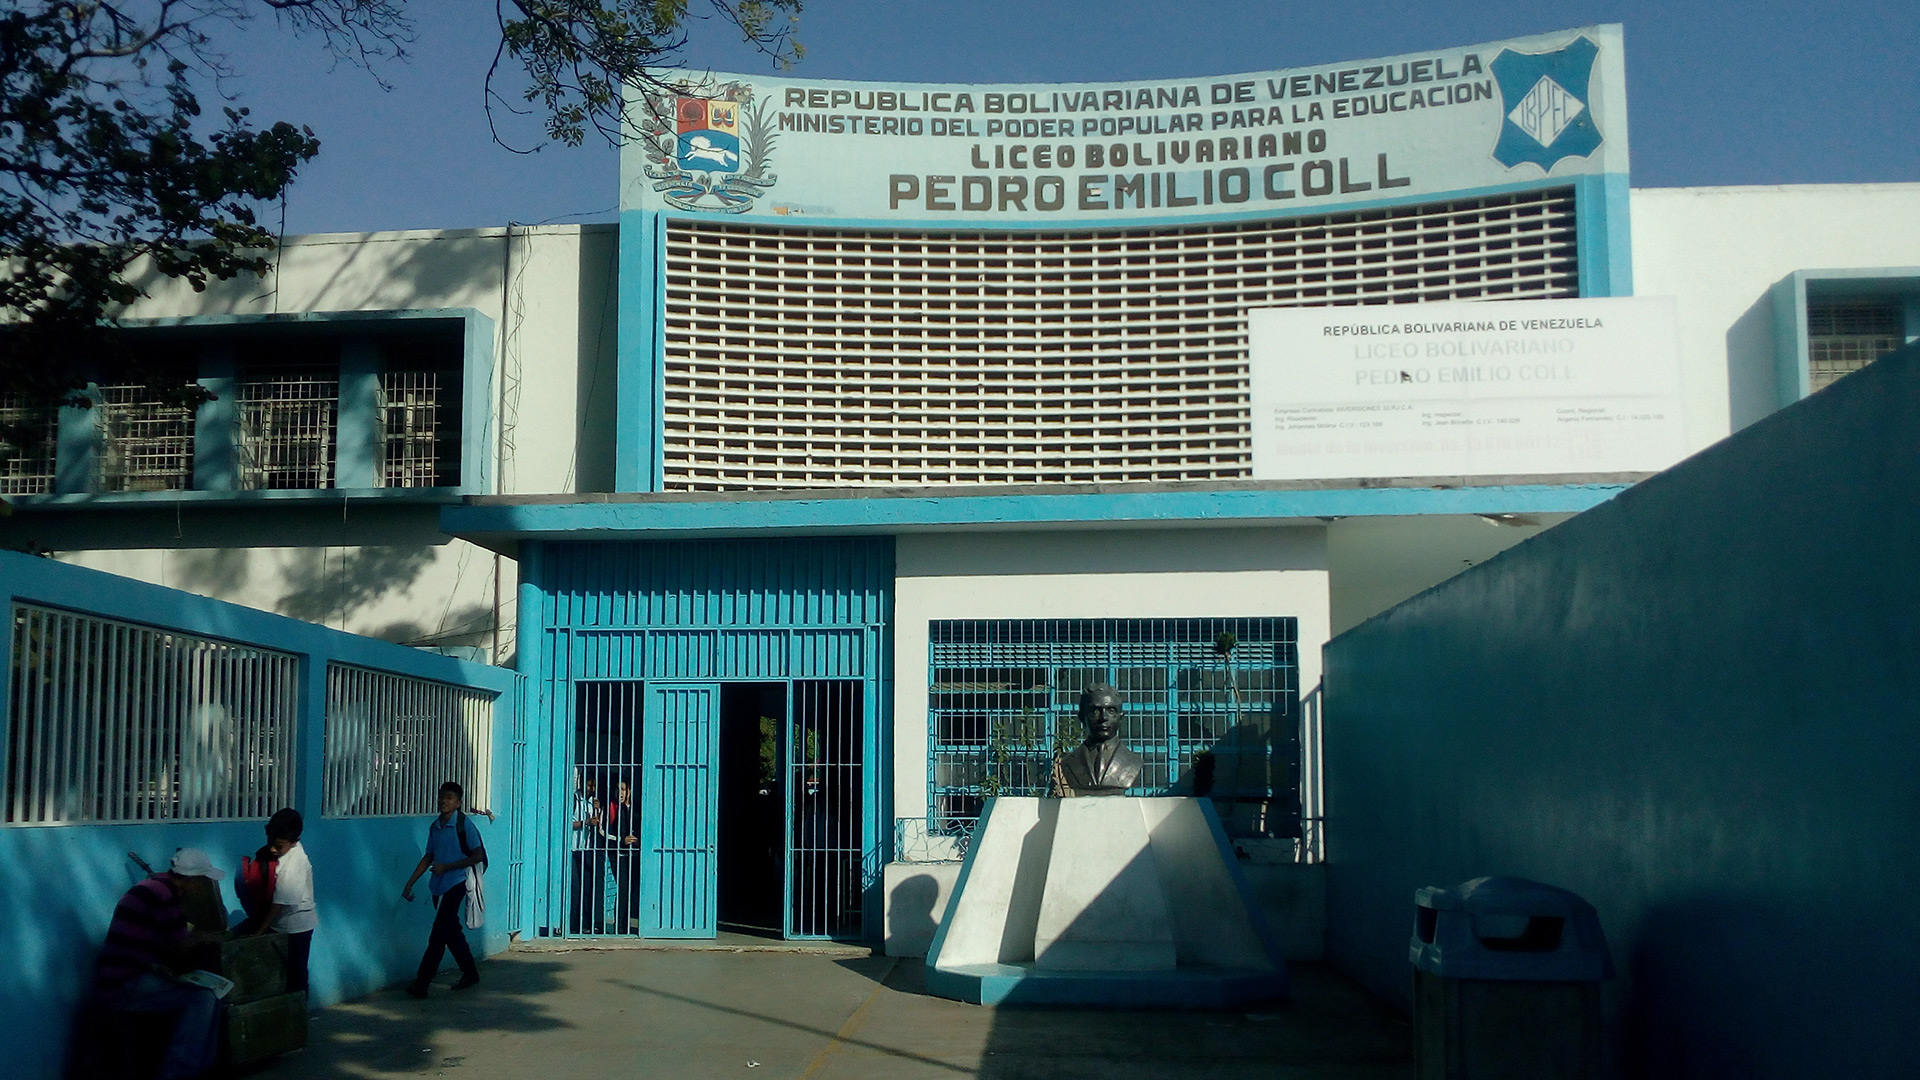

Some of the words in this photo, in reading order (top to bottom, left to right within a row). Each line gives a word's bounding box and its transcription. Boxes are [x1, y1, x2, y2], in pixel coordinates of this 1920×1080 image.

[784, 88, 974, 114] REPUBLICA
[983, 86, 1202, 114] BOLIVARIANA
[1210, 82, 1256, 105] DE
[1266, 54, 1484, 99] VENEZUELA
[778, 112, 924, 137] MINISTERIO
[931, 114, 980, 137] DEL
[986, 115, 1074, 138] PODER
[1081, 113, 1204, 137] POPULAR
[1210, 107, 1284, 131] PARA
[1292, 102, 1324, 124] LA
[1332, 80, 1493, 119] EDUCACION
[971, 144, 1075, 170] LICEO
[1085, 129, 1327, 167] BOLIVARIANO
[888, 174, 1065, 212] PEDRO
[1076, 165, 1252, 211] EMILIO
[1262, 152, 1412, 200] COLL
[1323, 322, 1400, 336] REPÚBLICA
[1403, 321, 1496, 335] BOLIVARIANA
[1498, 320, 1518, 331] DE
[1520, 317, 1604, 331] VENEZUELA
[1354, 342, 1419, 360] LICEO
[1425, 337, 1576, 359] BOLIVARIANO
[1437, 366, 1512, 384] EMILIO
[1518, 364, 1577, 382] COLL
